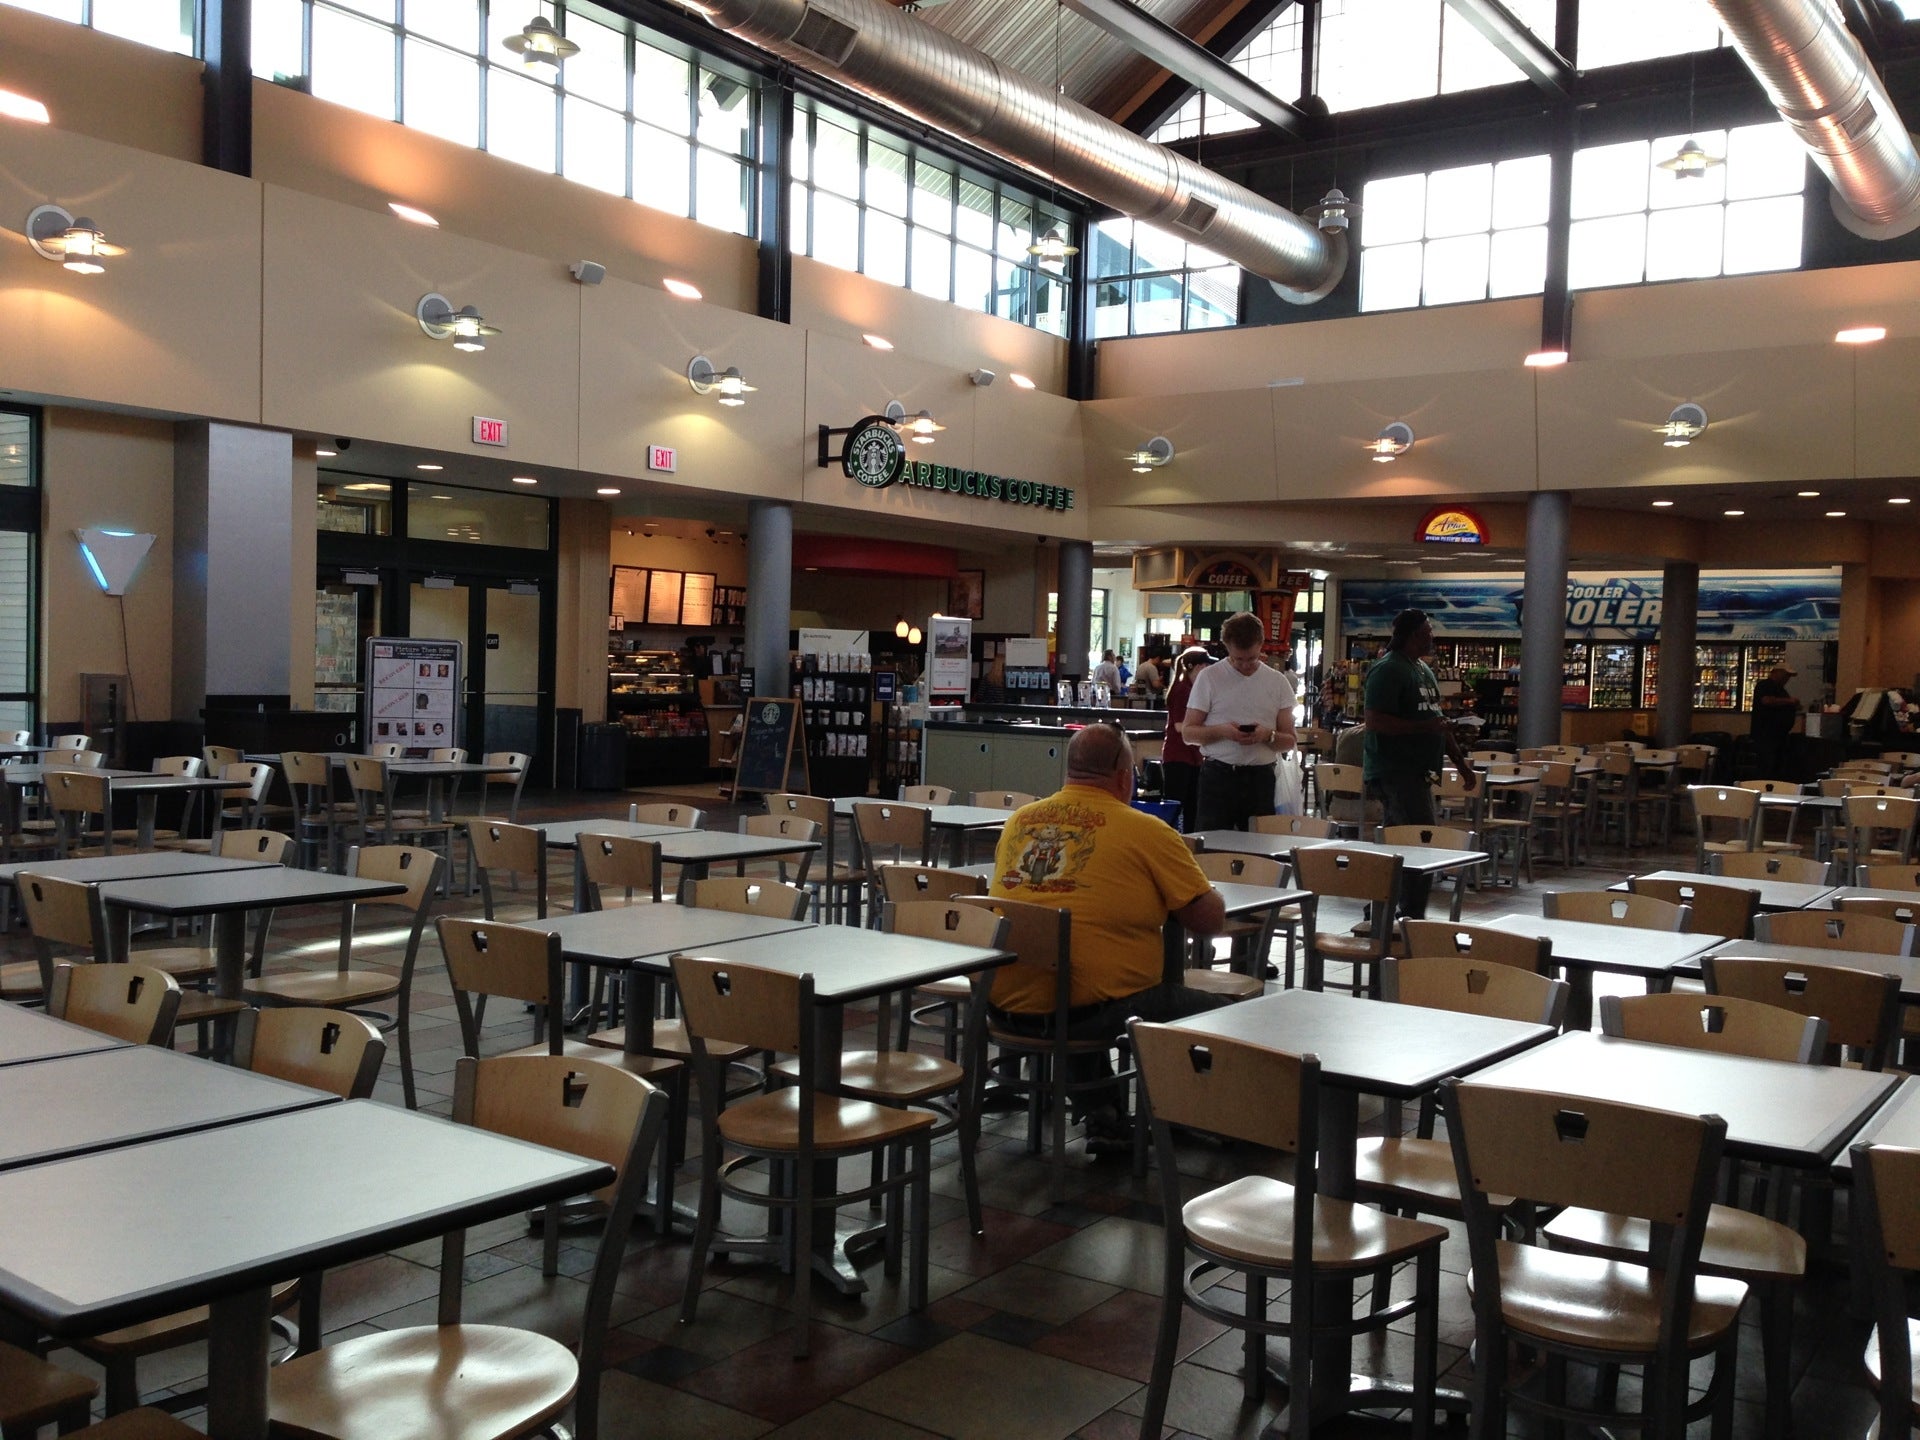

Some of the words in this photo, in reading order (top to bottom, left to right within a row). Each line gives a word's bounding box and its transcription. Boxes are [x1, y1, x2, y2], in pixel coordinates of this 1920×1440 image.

[480, 420, 503, 443] EXIT
[853, 428, 896, 456] STARBUCKS
[655, 449, 673, 469] EXIT
[856, 468, 889, 485] COFFEE
[897, 458, 1002, 499] ARBUCKS
[1005, 477, 1074, 511] COFFEE
[1208, 573, 1249, 586] COFFEE
[1279, 575, 1304, 586] FEE
[1566, 584, 1625, 599] COOLER
[1271, 611, 1281, 639] FRESH
